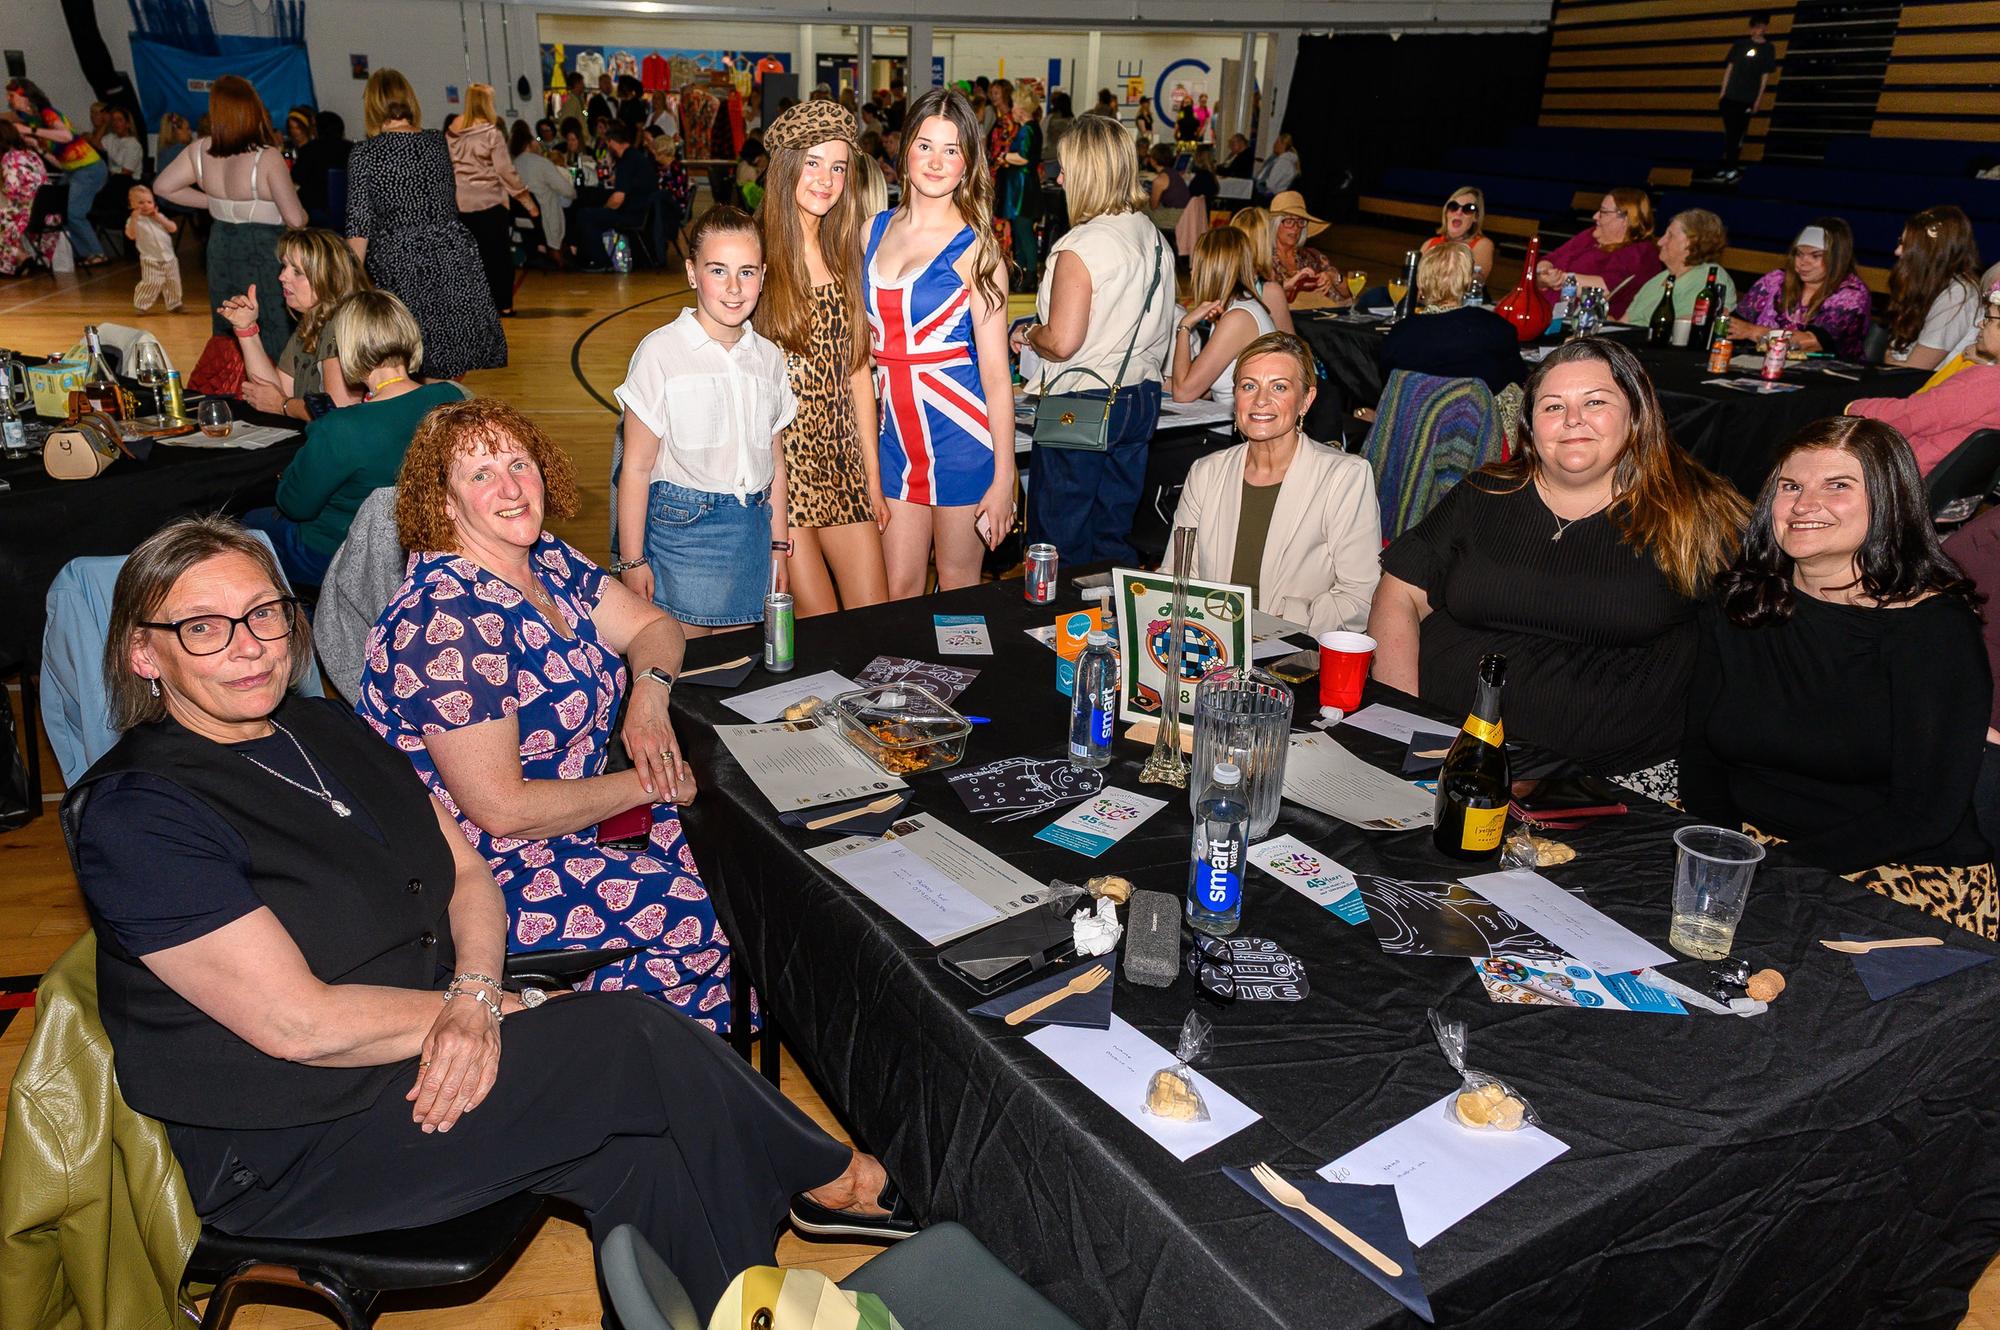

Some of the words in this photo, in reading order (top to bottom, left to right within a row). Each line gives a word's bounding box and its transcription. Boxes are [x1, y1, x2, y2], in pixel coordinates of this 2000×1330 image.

[1158, 602, 1205, 620] Tble
[1180, 690, 1190, 704] 8
[1102, 686, 1115, 739] smart
[1078, 814, 1099, 824] 45
[1229, 840, 1240, 869] water
[1209, 839, 1230, 903] smart
[1306, 877, 1326, 890] 45
[1212, 984, 1302, 1000] VIBE
